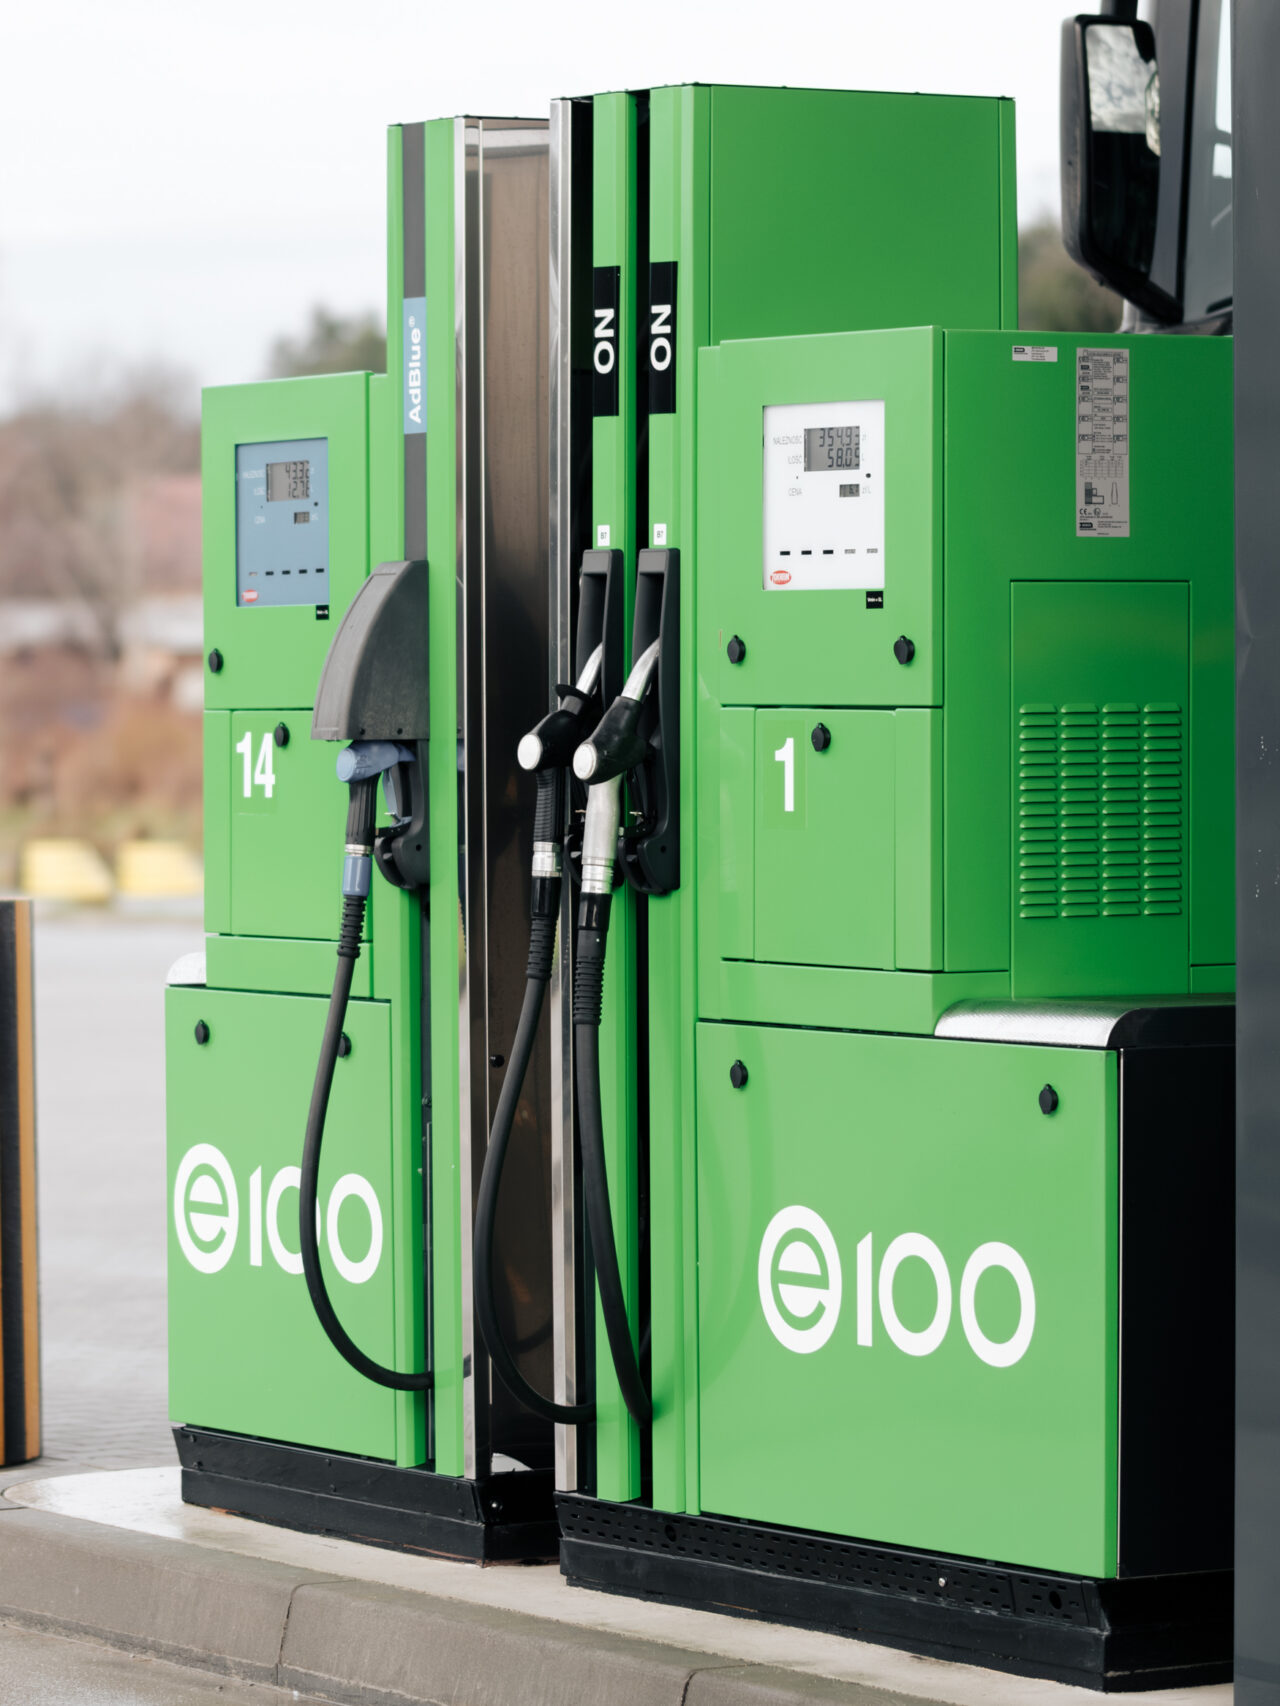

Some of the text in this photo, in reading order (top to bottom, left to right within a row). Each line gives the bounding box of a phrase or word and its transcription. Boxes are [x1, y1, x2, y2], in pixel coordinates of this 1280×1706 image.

[593, 308, 615, 374] ON
[650, 304, 671, 371] ON
[236, 731, 276, 798] 14
[774, 737, 795, 812] 1
[758, 1205, 1036, 1368] e100
